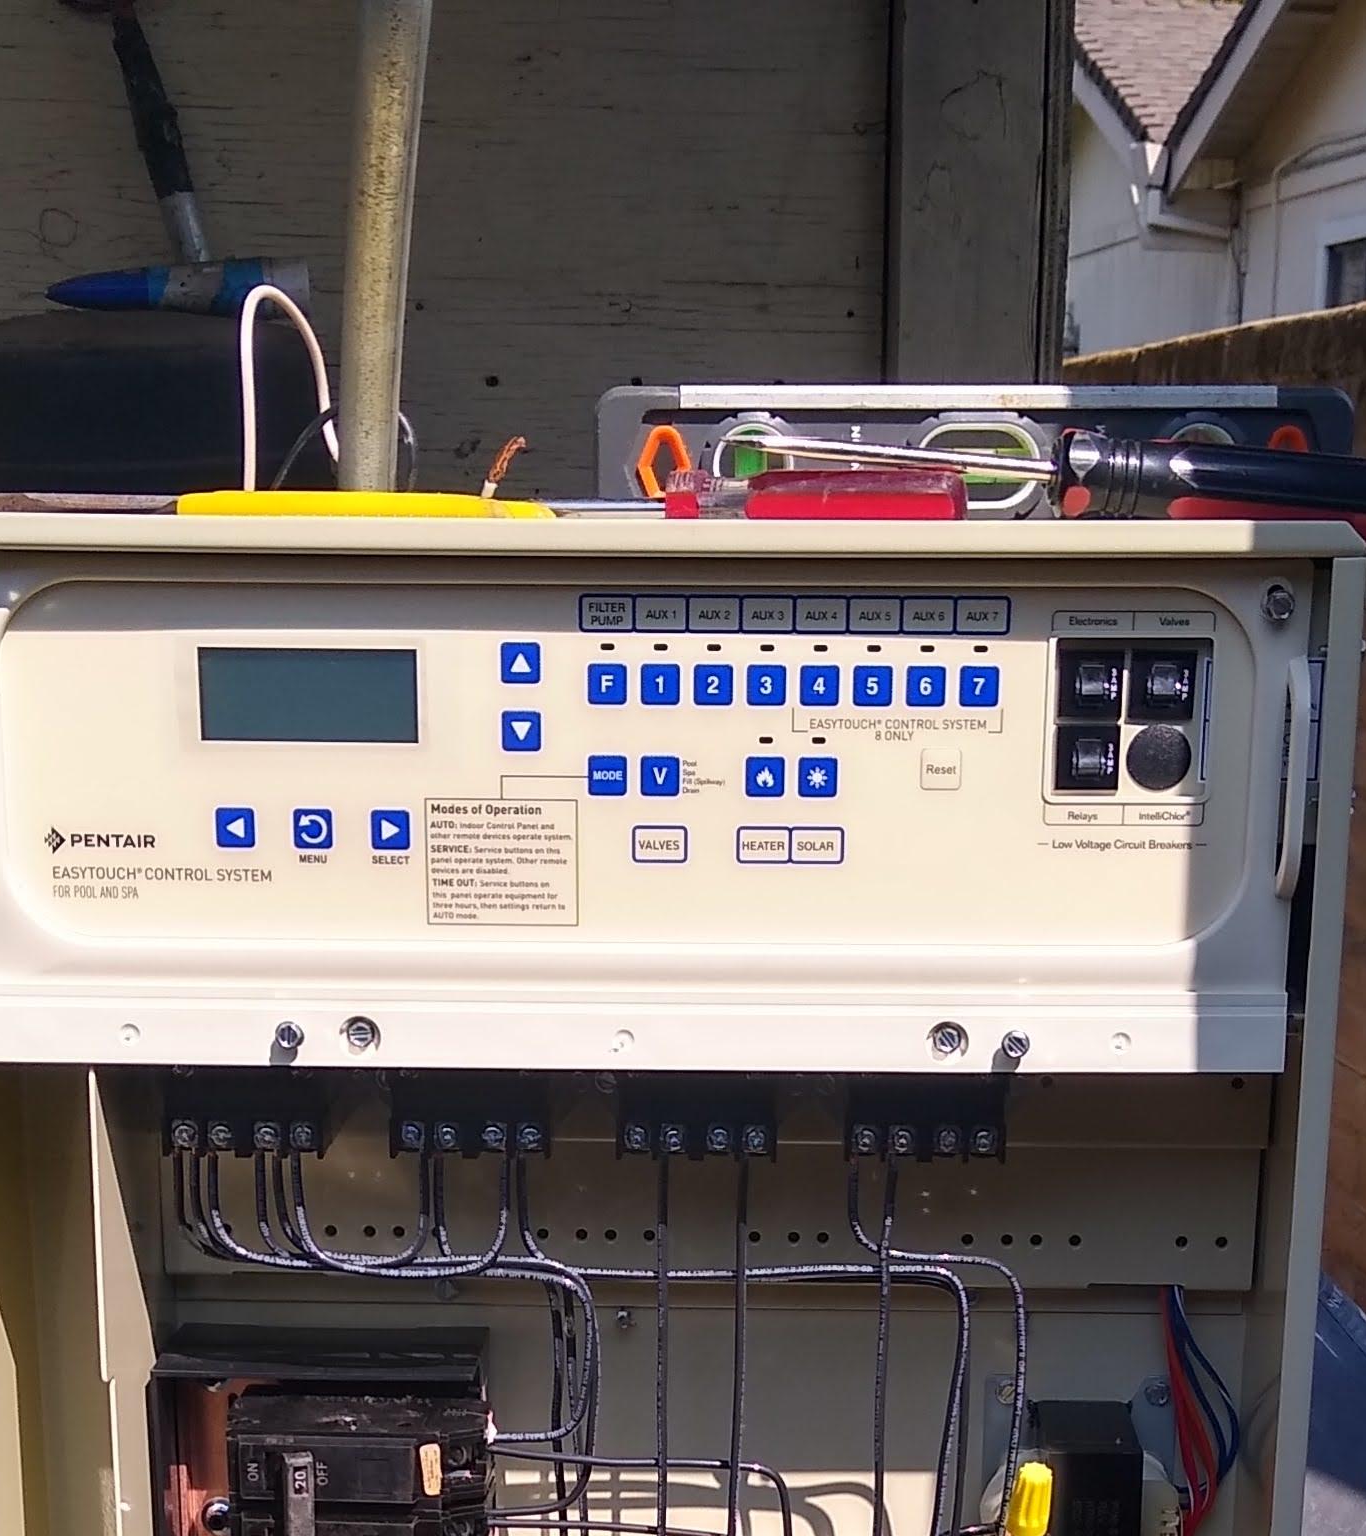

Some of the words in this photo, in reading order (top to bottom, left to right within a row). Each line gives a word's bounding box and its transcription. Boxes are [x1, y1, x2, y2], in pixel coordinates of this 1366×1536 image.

[589, 603, 625, 612] FILTER
[646, 610, 669, 619] AUX
[672, 611, 677, 619] 1
[698, 610, 721, 619] AUX
[724, 611, 730, 619] 2
[751, 611, 774, 620] AUX
[778, 611, 784, 620] 3
[805, 611, 828, 620] AUX
[831, 612, 837, 620] 4
[859, 612, 881, 620] AUX
[885, 612, 891, 621] 5
[913, 612, 935, 621] AUX
[938, 612, 944, 621] 6
[966, 612, 989, 621] AUX
[992, 612, 998, 621] 7
[591, 616, 623, 625] PUMP
[1069, 617, 1118, 626] Electronics
[1159, 617, 1190, 626] Valves
[601, 676, 614, 692] F
[655, 676, 663, 693] 1
[707, 676, 719, 693] 2
[760, 676, 772, 694] 3
[813, 677, 825, 694] 4
[866, 678, 878, 695] 5
[920, 678, 932, 695] 6
[973, 678, 985, 695] 7
[885, 719, 938, 730] CONTROL
[943, 720, 987, 730] SYSTEM
[875, 732, 881, 741] 8
[884, 732, 913, 741] ONLY
[683, 769, 695, 777] Spa
[926, 764, 956, 775] Reset
[593, 770, 623, 780] MODE
[653, 768, 667, 784] V
[431, 804, 468, 814] Modes
[471, 804, 481, 814] of
[485, 805, 542, 816] Operation
[1068, 812, 1097, 820] Relays
[430, 821, 457, 829] AUTO:
[71, 834, 155, 848] PENTAIR
[639, 840, 680, 851] VALVES
[742, 841, 785, 851] HEATER
[797, 841, 834, 851] SOLAR
[1052, 840, 1072, 849] Low
[1074, 840, 1111, 850] Voltage
[1114, 841, 1146, 849] Circuit
[1149, 841, 1192, 849] Breakers
[431, 845, 472, 853] SERVICE:
[299, 855, 327, 863] MENU
[372, 856, 409, 865] SELECT
[145, 868, 212, 881] CONTROL
[217, 870, 272, 882] SYSTEM
[53, 886, 70, 898] FOR
[73, 886, 97, 898] POOL
[100, 887, 119, 898] AND
[122, 887, 139, 899] SPA
[499, 903, 529, 911] settings
[248, 1462, 259, 1481] ON
[318, 1461, 329, 1485] OFF
[295, 1471, 306, 1489] 20
